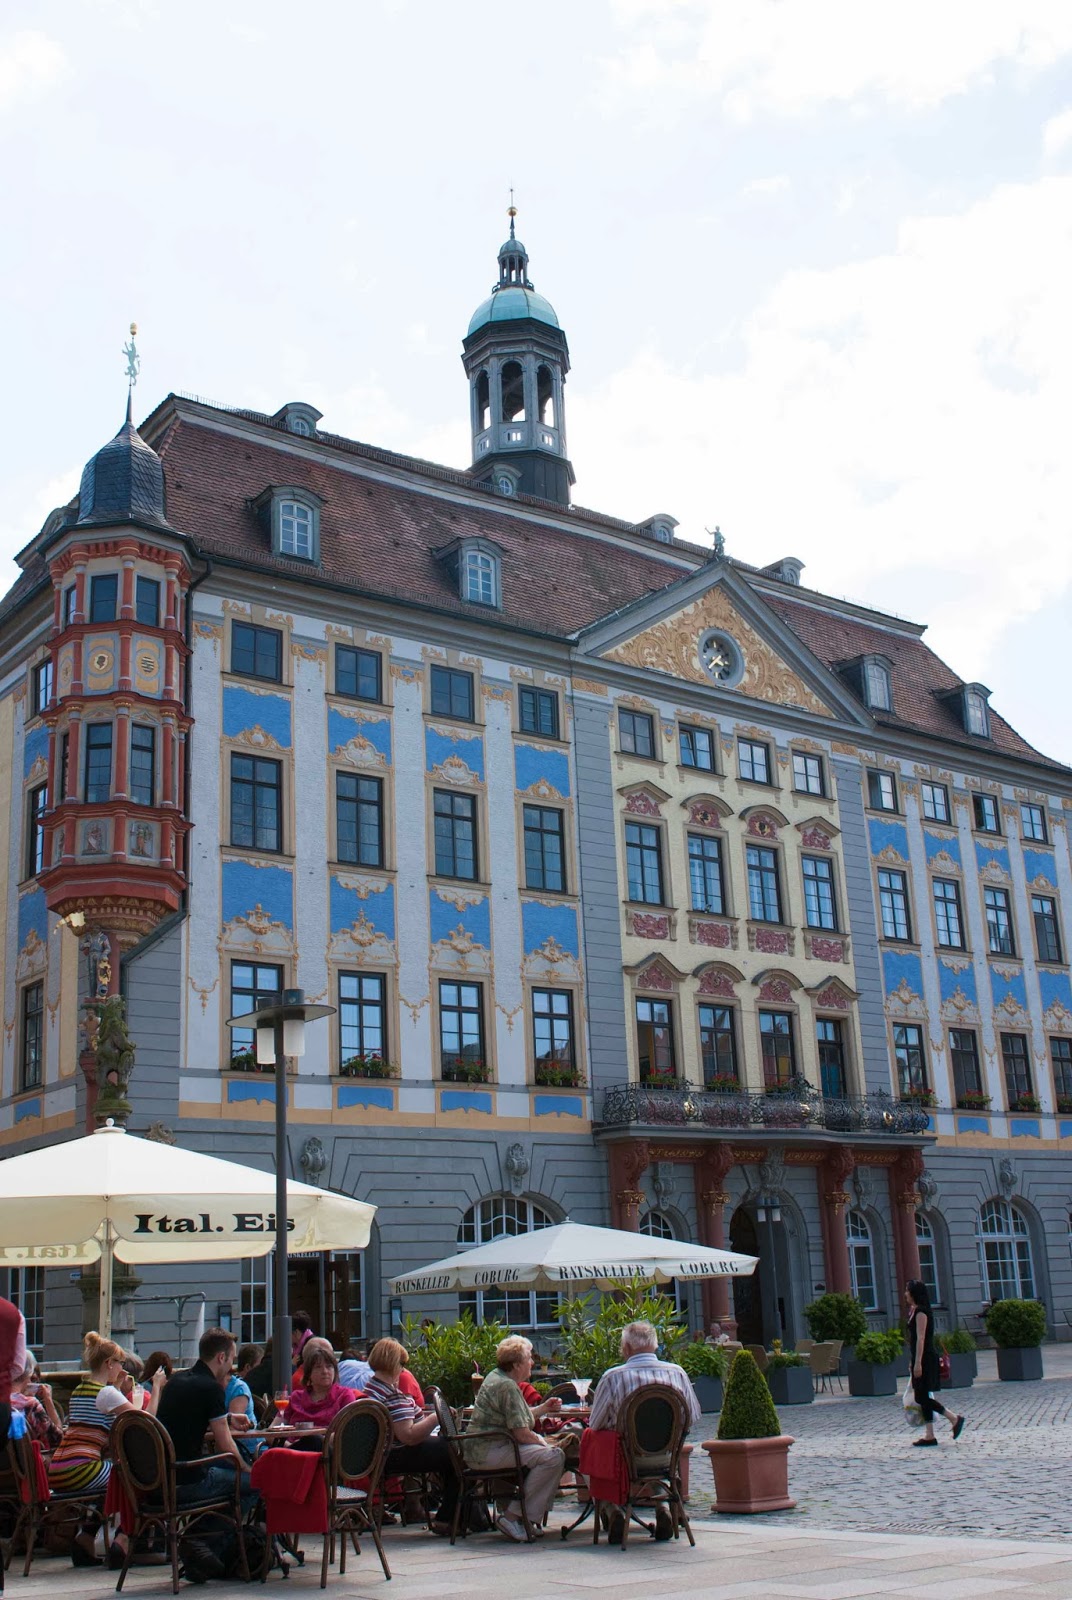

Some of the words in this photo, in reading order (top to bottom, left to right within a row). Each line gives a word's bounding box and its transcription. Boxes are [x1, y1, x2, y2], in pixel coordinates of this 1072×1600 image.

[133, 1213, 224, 1233] Ital.
[232, 1213, 295, 1232] Eis
[559, 1264, 645, 1279] RATSKELLER
[679, 1260, 739, 1275] COBURG
[395, 1275, 450, 1294] RATSKELLER
[474, 1268, 520, 1285] COBURG
